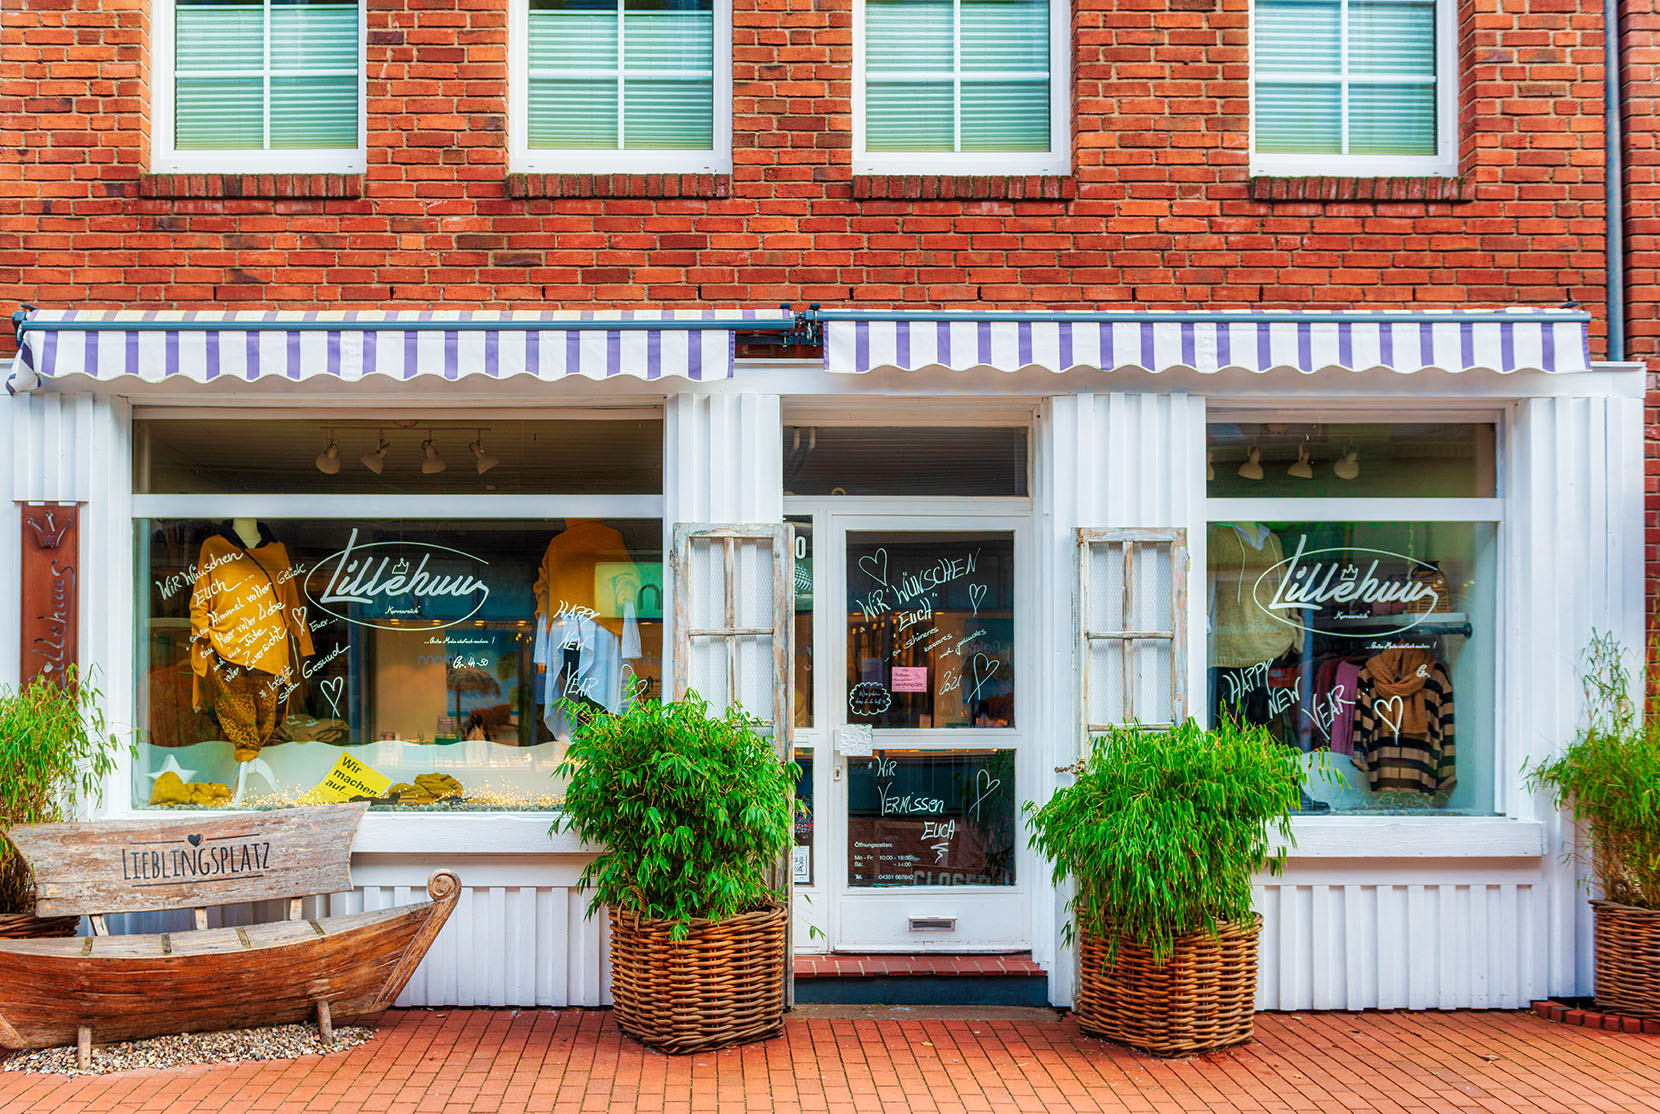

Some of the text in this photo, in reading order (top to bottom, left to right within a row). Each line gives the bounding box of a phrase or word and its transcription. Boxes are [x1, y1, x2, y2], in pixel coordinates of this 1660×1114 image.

[892, 547, 981, 604] WÜNSCHEN
[552, 599, 601, 626] HAPPY
[898, 597, 932, 632] EUCH
[556, 631, 587, 652] NEW
[562, 661, 600, 698] YEAR
[938, 670, 962, 696] 2021
[1222, 657, 1274, 704] HAPPY
[1268, 676, 1302, 720] NEW
[1301, 684, 1357, 741] YEAR
[342, 756, 362, 774] Wir
[325, 779, 347, 793] auf
[333, 769, 377, 797] machen
